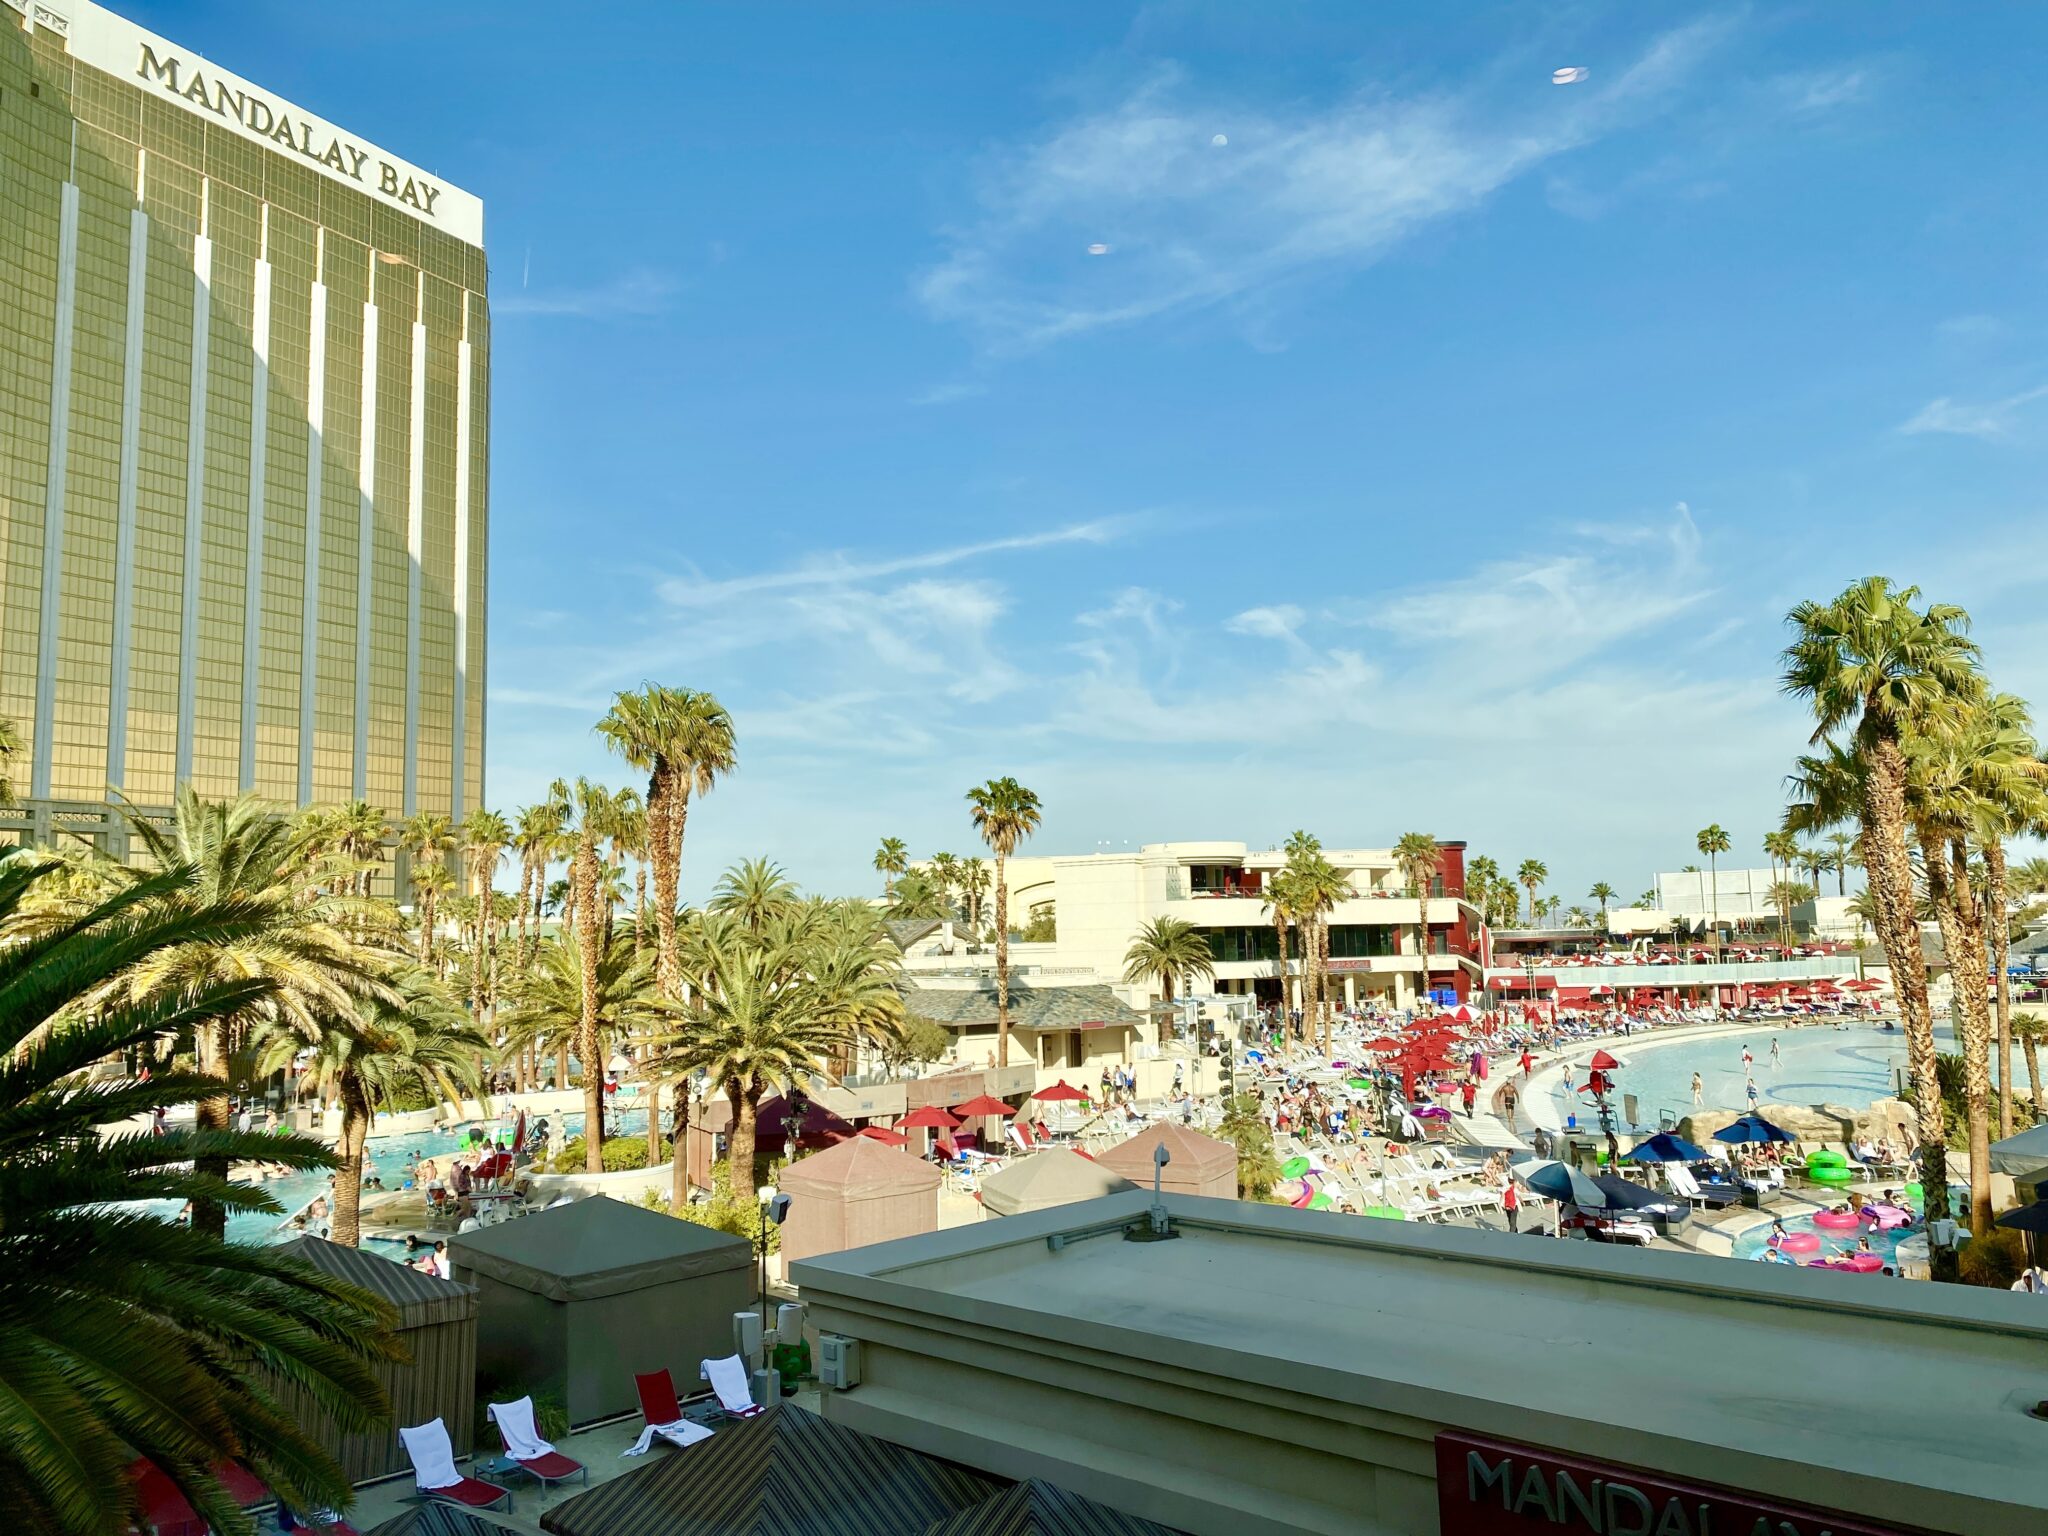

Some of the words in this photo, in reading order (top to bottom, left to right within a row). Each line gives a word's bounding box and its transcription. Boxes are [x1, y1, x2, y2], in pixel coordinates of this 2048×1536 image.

[136, 42, 369, 182] MANDALAY
[378, 161, 440, 216] BAY
[1467, 1451, 1833, 1536] MANDA
